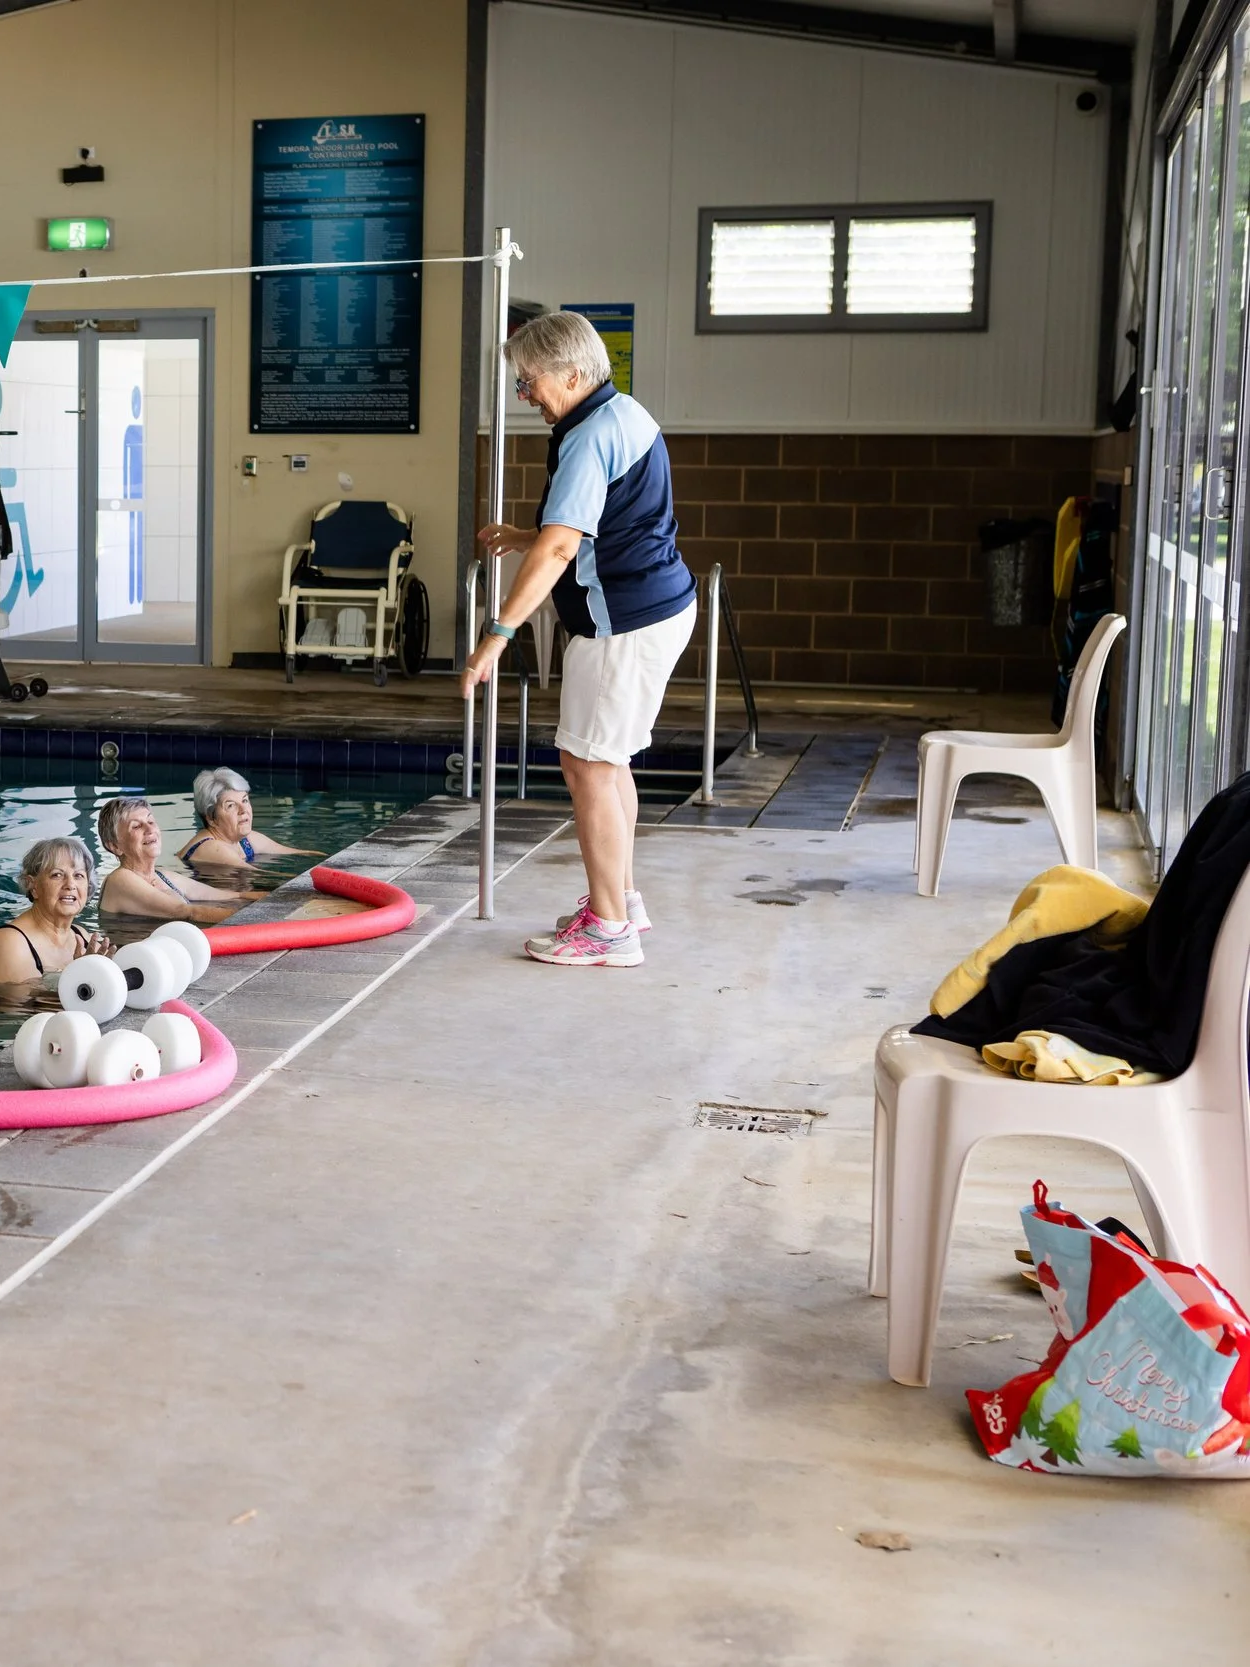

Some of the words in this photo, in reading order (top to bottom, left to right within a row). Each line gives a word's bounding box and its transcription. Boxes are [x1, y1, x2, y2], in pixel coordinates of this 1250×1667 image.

[278, 145, 310, 153] TEMORA
[312, 144, 343, 152] INDOOR
[345, 143, 375, 151] HEATED
[378, 142, 399, 150] POOL
[308, 150, 369, 159] CONTRIBUTORS
[1085, 1351, 1204, 1434] Christmas
[1119, 1338, 1191, 1414] Merry
